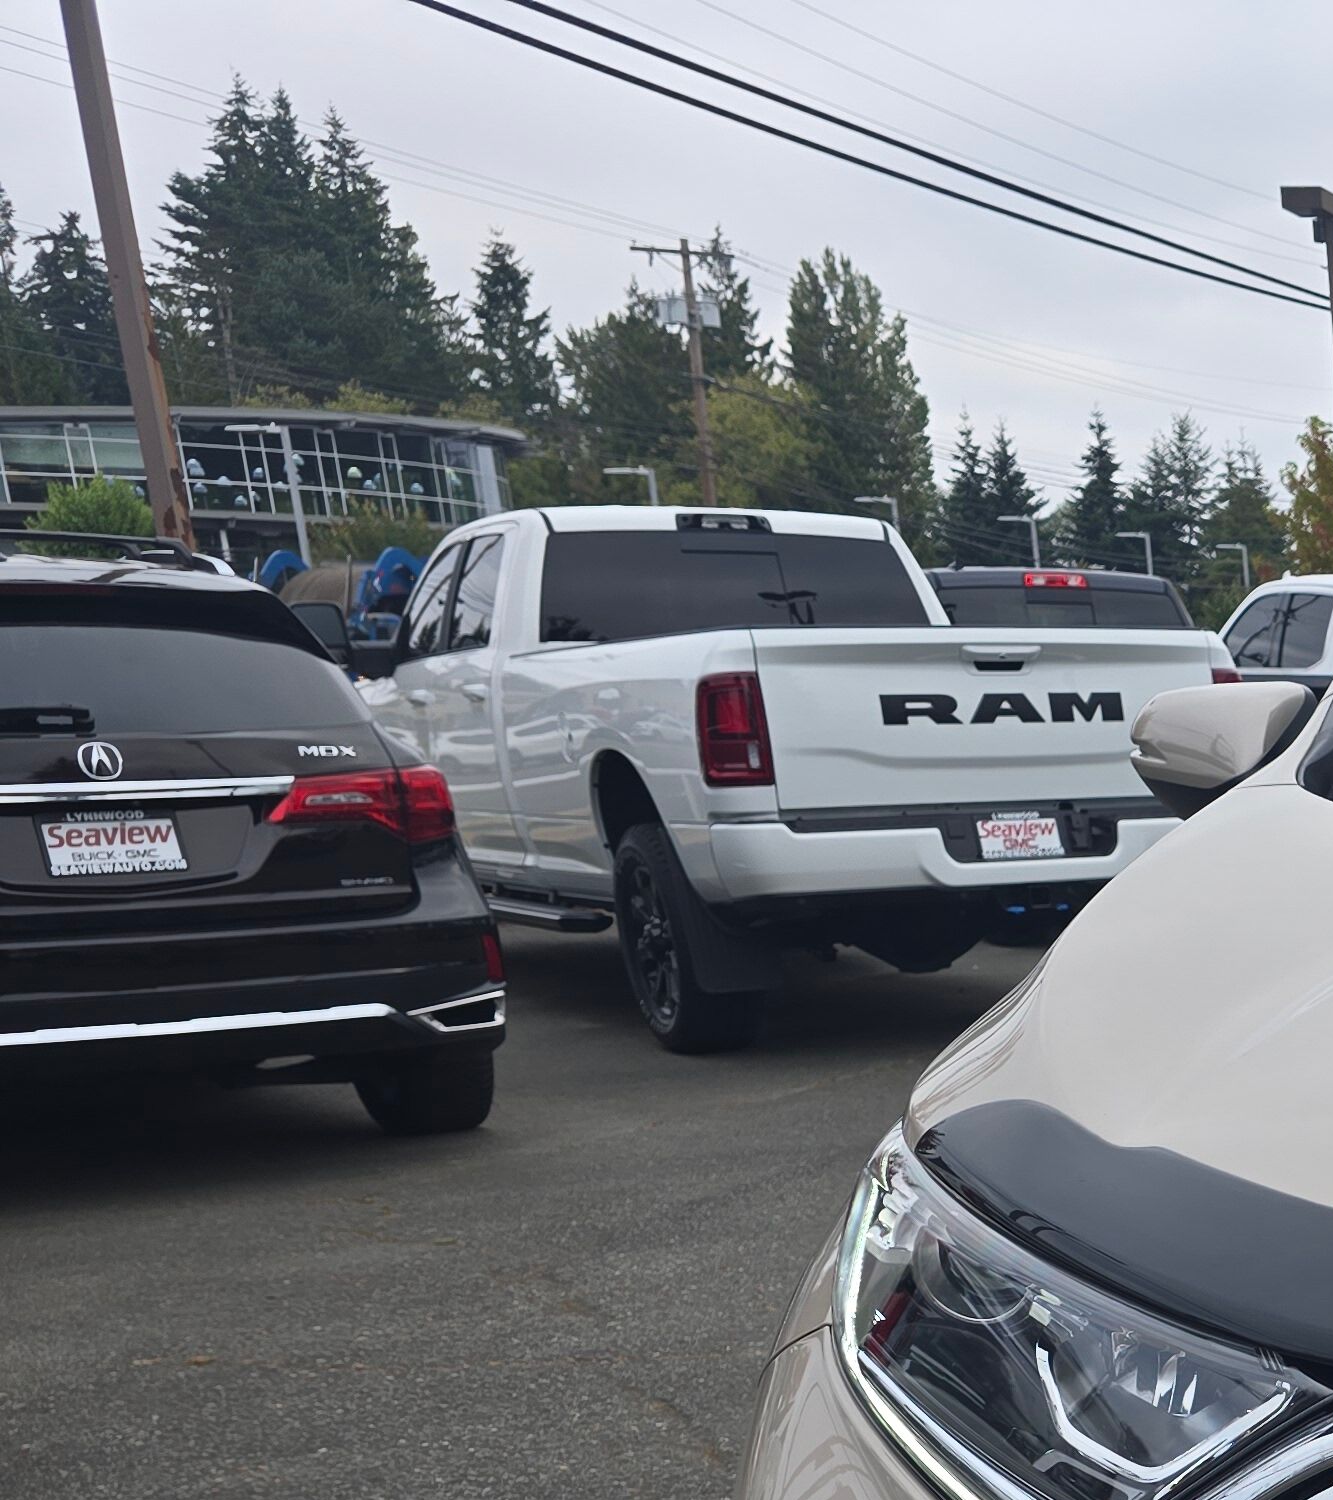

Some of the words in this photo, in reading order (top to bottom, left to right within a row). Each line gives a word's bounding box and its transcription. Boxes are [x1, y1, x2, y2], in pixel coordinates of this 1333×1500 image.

[878, 691, 1125, 726] RAM
[297, 745, 357, 757] MDX
[65, 809, 145, 822] LYNNWOOD
[47, 822, 173, 849] Seaview
[980, 819, 1055, 839] Seaview
[71, 850, 118, 863] BUICK
[124, 848, 160, 860] GMC
[50, 858, 188, 877] SEAVIEWAUTO.COM
